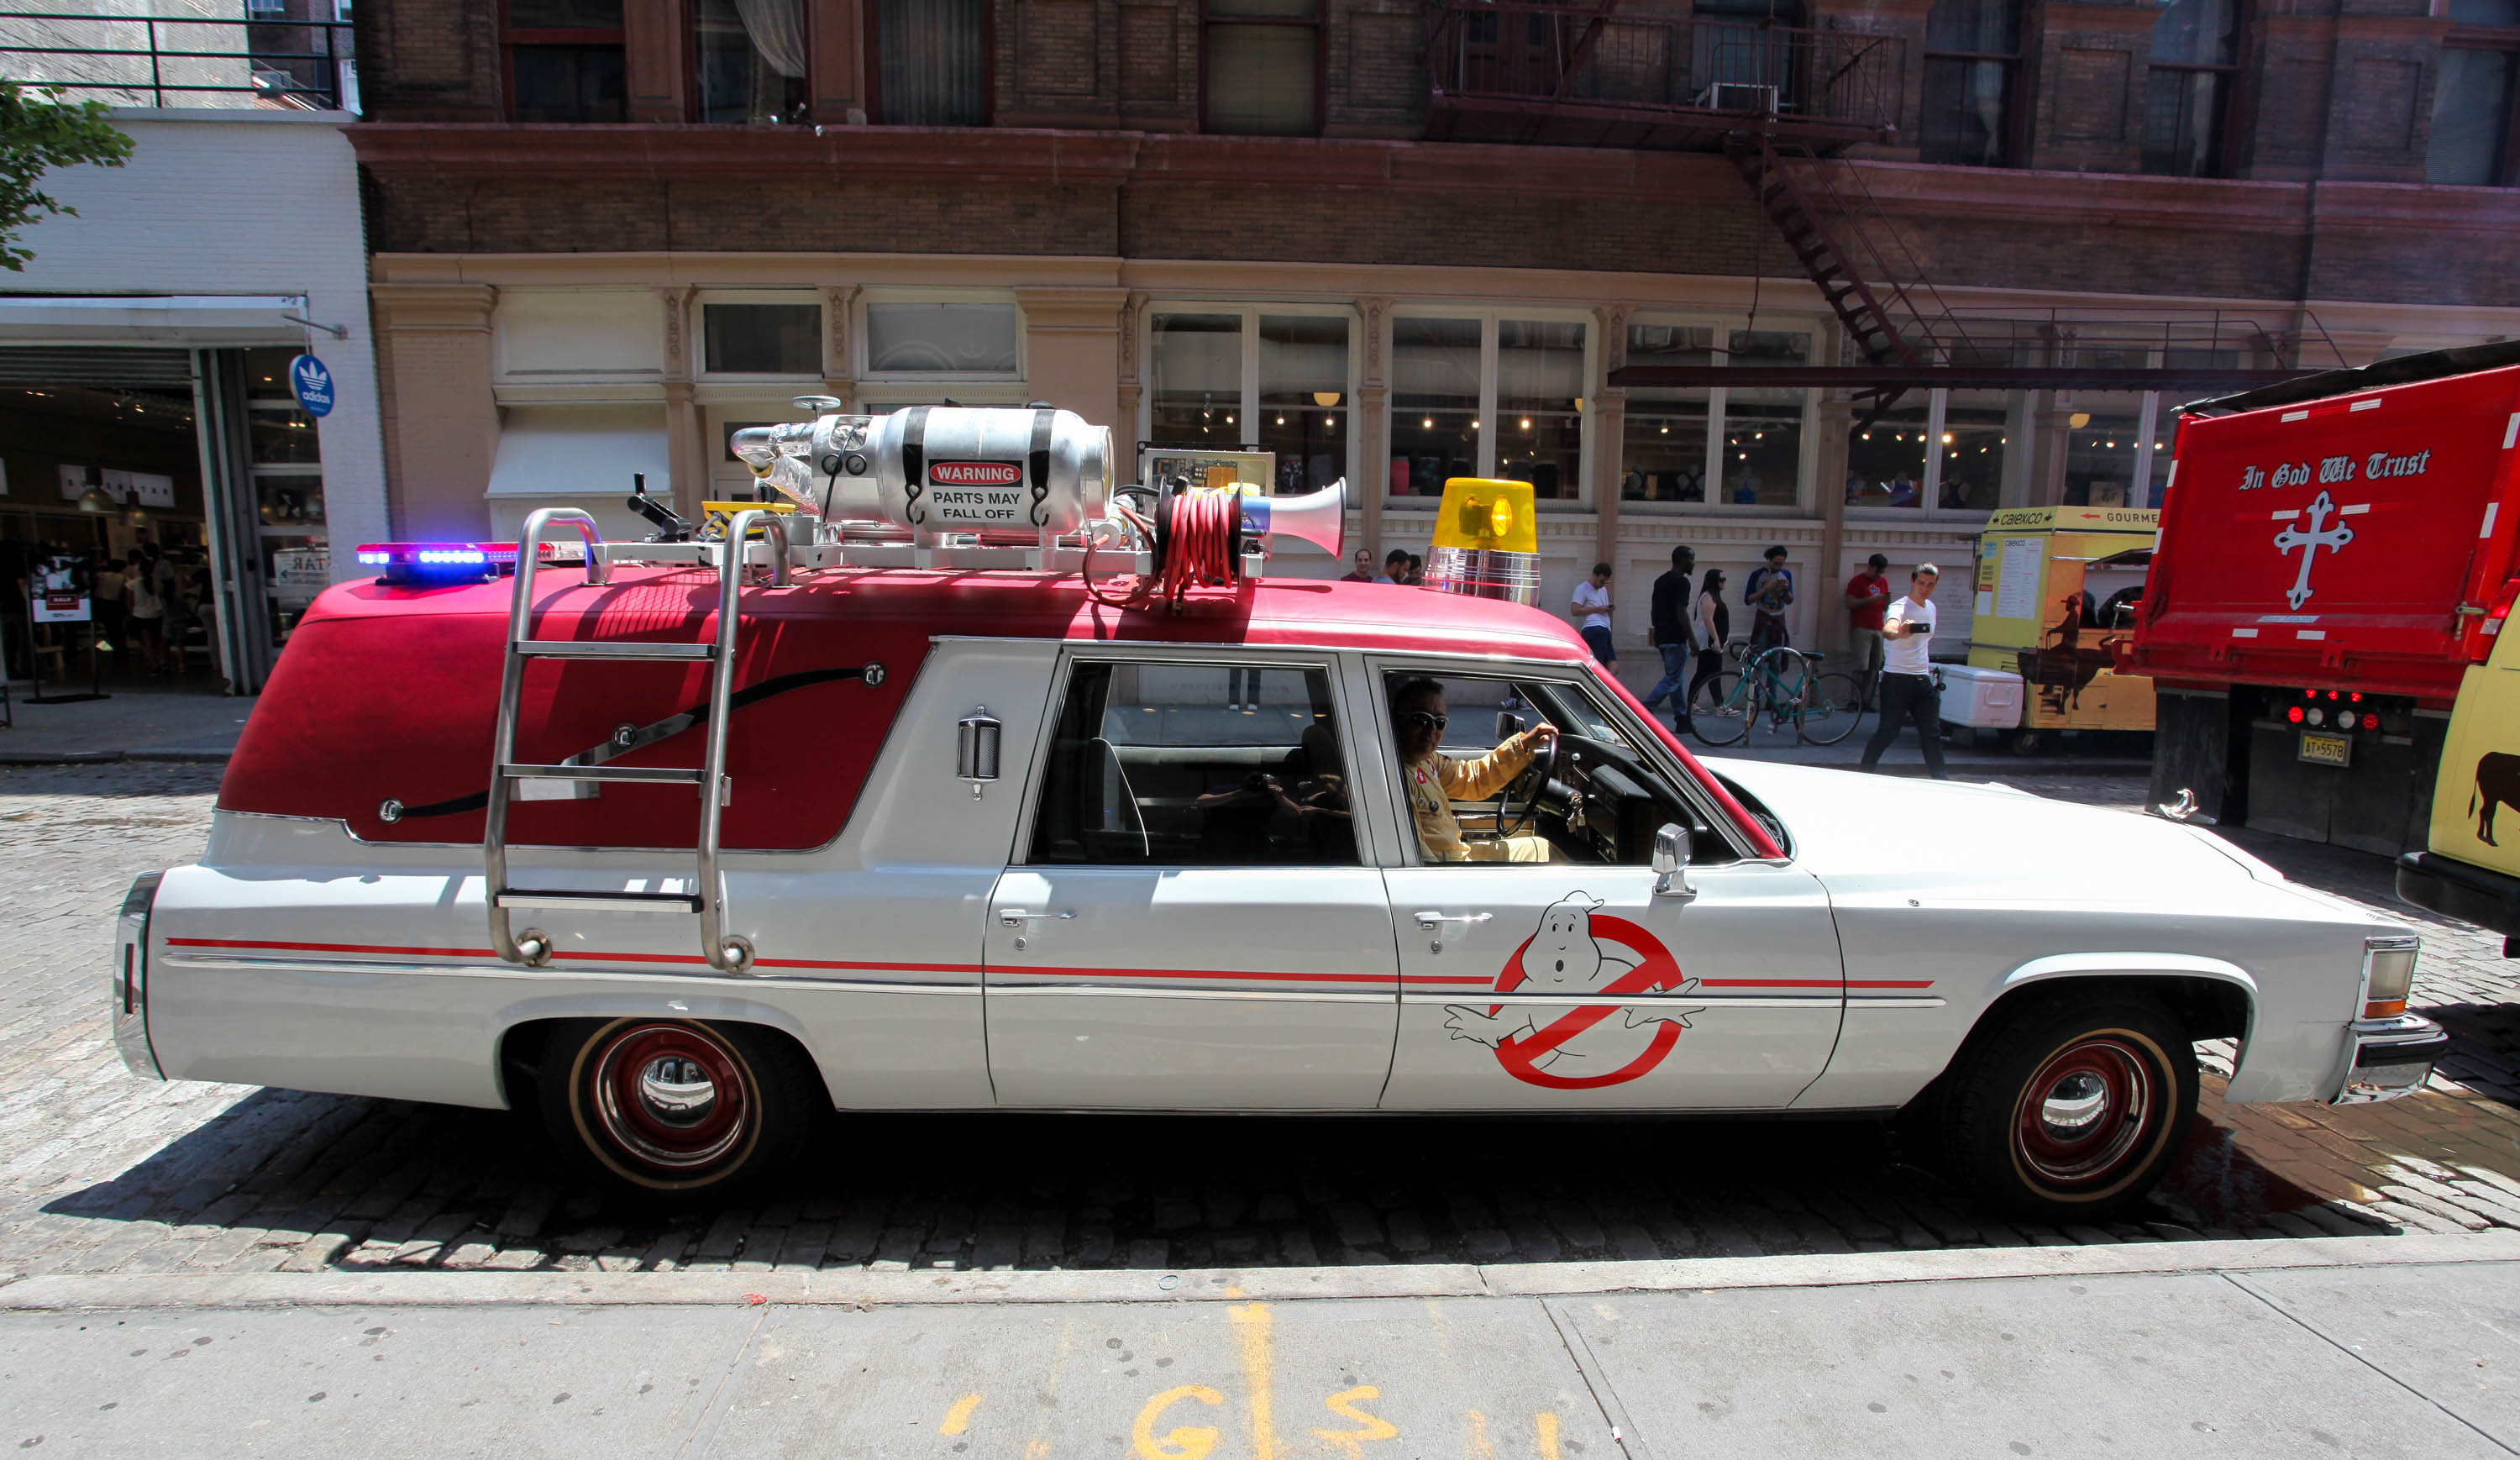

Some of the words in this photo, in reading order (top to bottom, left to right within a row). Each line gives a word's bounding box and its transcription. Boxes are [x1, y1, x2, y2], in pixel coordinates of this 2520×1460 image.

[302, 391, 331, 404] adidas
[937, 466, 1016, 481] WARNING
[2239, 465, 2265, 491] In
[2271, 462, 2312, 489] God
[2318, 454, 2357, 485] We
[2365, 448, 2432, 481] Trust
[933, 491, 984, 504] PARTS
[988, 493, 1021, 505] MAY
[942, 508, 981, 519] FALL
[984, 509, 1015, 519] OFF
[2001, 512, 2043, 526] calexico
[2107, 512, 2158, 523] GOURME
